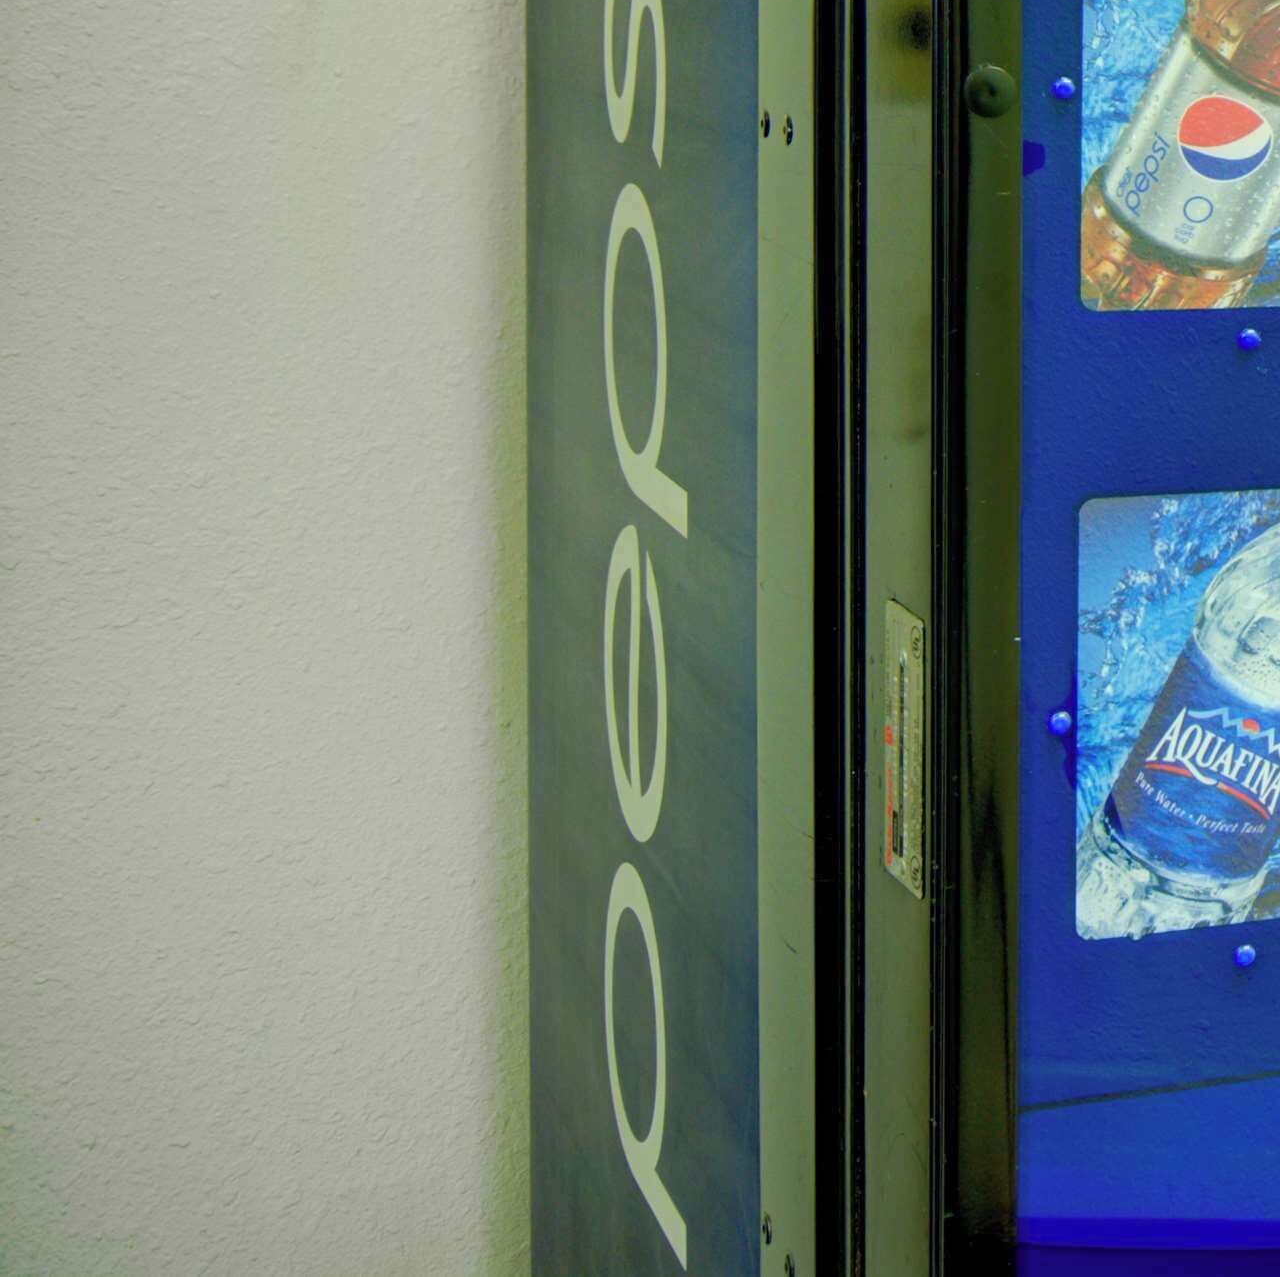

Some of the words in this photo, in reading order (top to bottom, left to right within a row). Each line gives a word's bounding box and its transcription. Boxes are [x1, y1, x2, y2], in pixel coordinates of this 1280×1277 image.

[1124, 131, 1172, 217] pepsi
[1135, 770, 1153, 796] Pure
[1155, 789, 1187, 818] Water
[1196, 813, 1239, 833] Perfect
